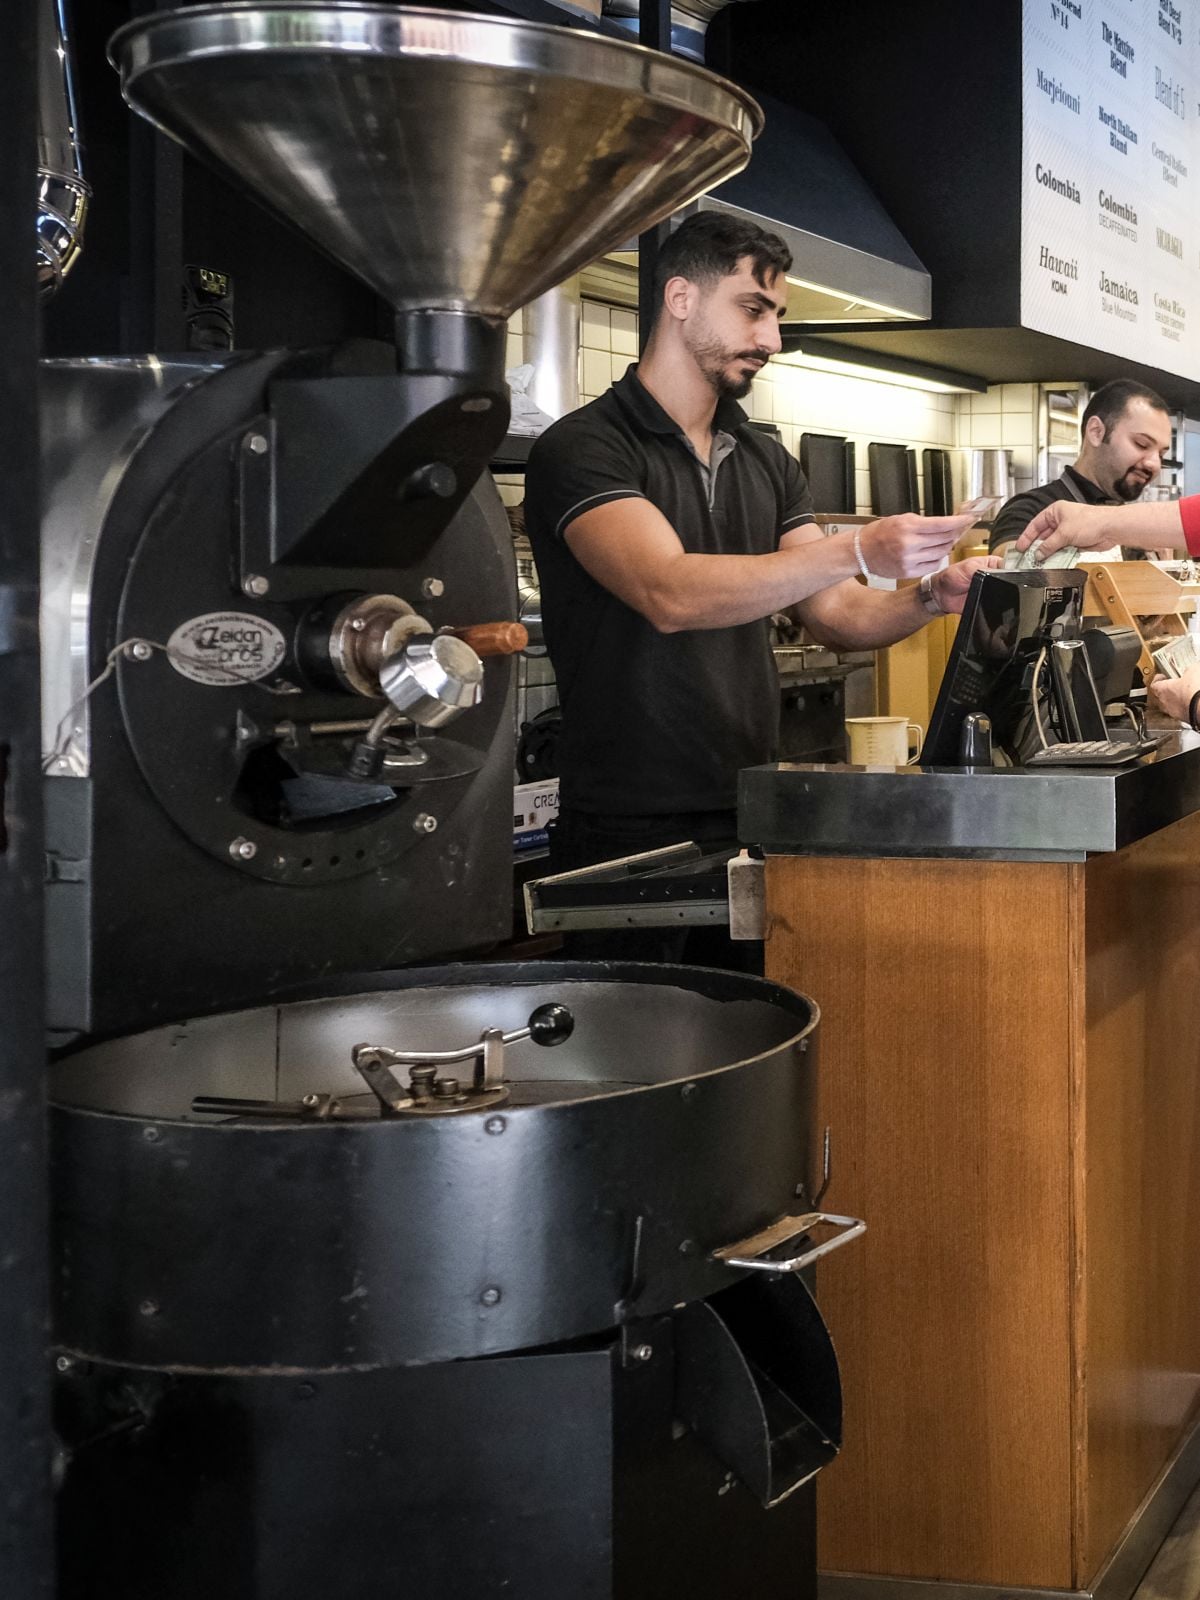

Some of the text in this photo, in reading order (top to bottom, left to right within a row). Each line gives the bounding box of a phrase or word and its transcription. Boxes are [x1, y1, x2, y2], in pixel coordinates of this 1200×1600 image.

[1102, 21, 1112, 46] The
[1110, 50, 1126, 79] Blend
[1099, 105, 1137, 144] North Italian
[1110, 131, 1127, 155] Blend
[1035, 163, 1081, 205] Colombia
[1099, 189, 1138, 225] Colombia
[1039, 246, 1078, 281] Hawaii
[1051, 280, 1067, 296] KONA
[1099, 271, 1139, 305] Jamaica
[1154, 292, 1186, 318] Costa Rica
